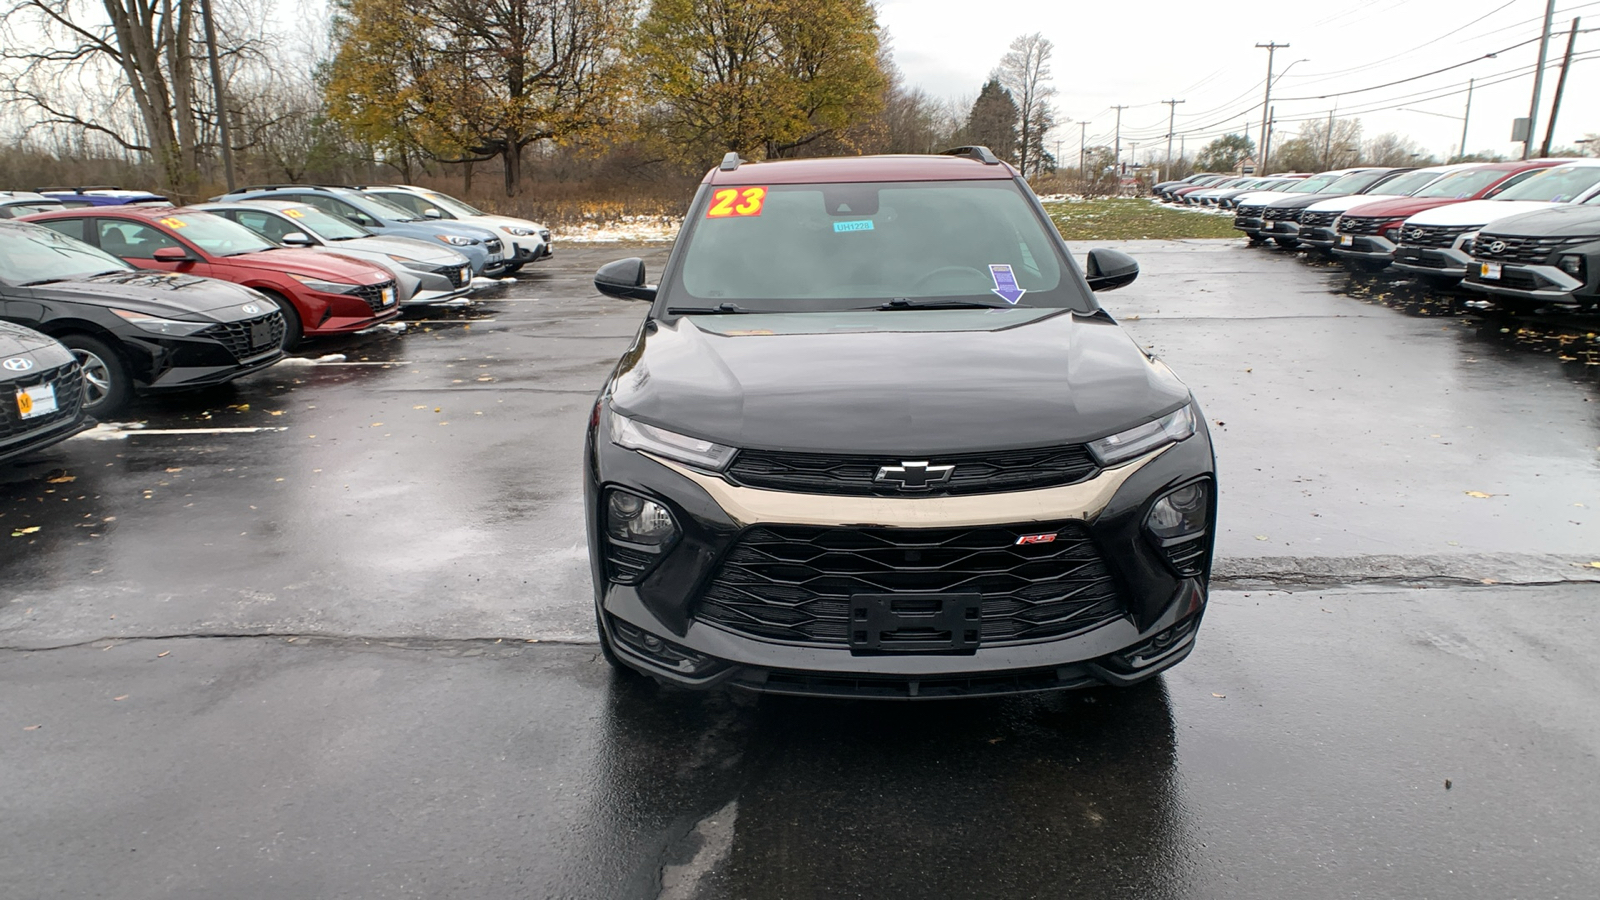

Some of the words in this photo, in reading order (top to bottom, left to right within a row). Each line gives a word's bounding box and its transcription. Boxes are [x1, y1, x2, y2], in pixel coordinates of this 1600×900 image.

[708, 188, 766, 216] 23
[836, 222, 870, 231] UH1228
[1015, 533, 1057, 545] RS
